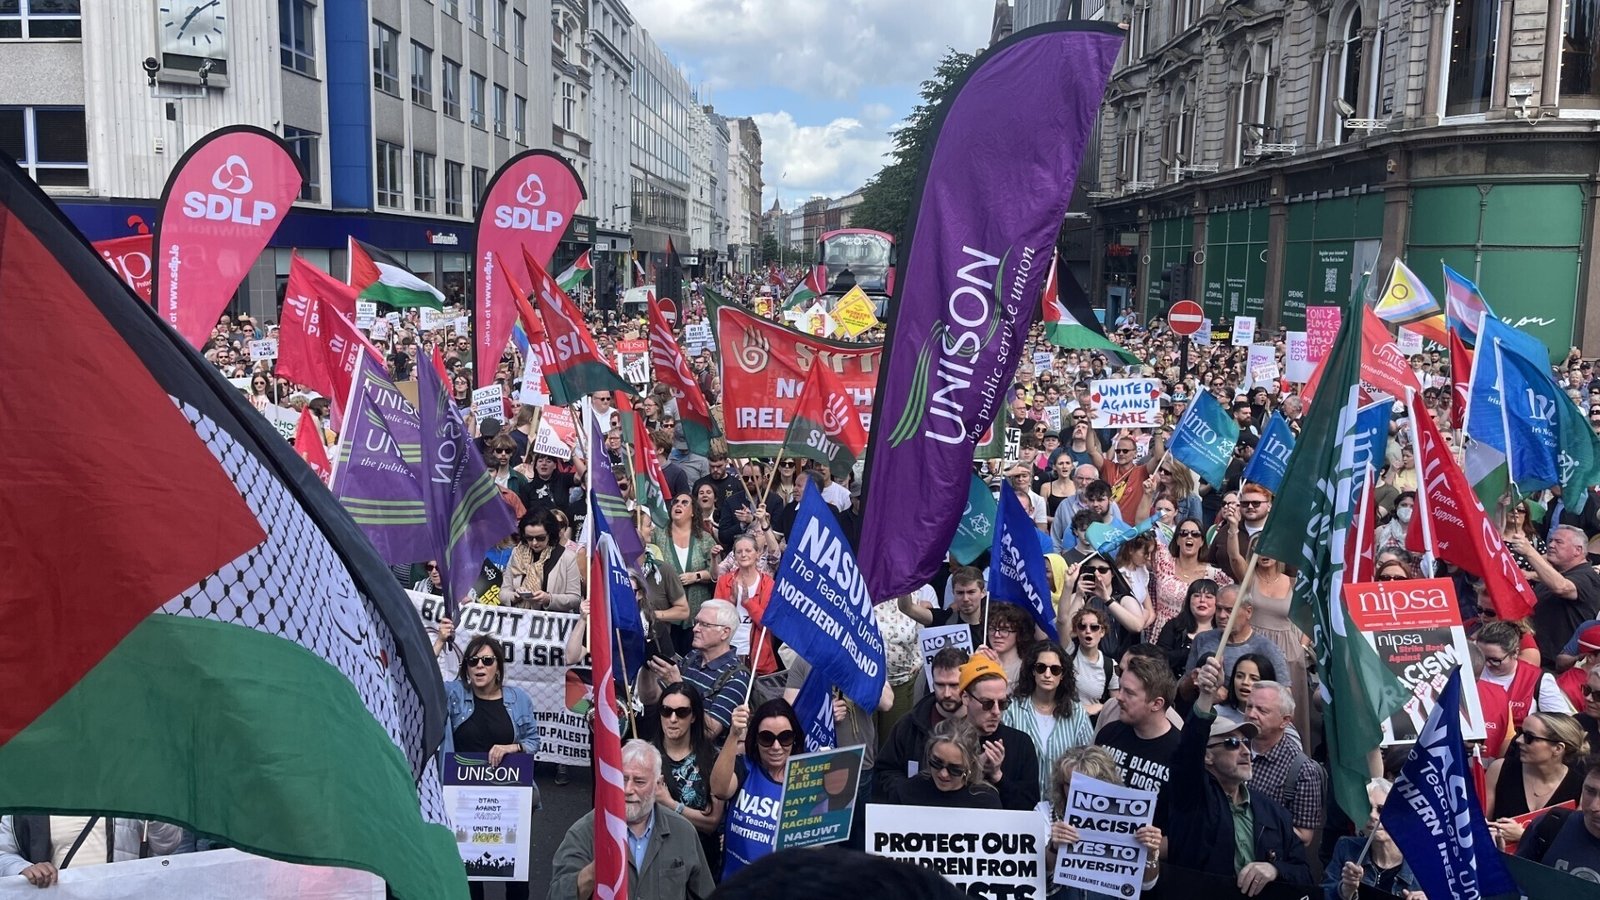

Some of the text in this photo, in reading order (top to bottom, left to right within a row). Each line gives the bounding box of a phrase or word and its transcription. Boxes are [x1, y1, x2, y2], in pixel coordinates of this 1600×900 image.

[182, 191, 276, 226] SDLP
[494, 205, 563, 232] SDLP
[168, 244, 182, 310] www.sdlp.ie
[483, 251, 494, 308] www.sdlp.ie
[169, 312, 177, 323] at
[485, 309, 491, 318] at
[1310, 308, 1335, 319] ONLY
[485, 320, 491, 329] us
[978, 367, 1003, 420] public
[997, 304, 1018, 364] service
[1011, 246, 1035, 301] union
[1311, 319, 1333, 329] LOVE
[620, 340, 645, 351] nipsa
[925, 245, 1000, 444] UNISON
[473, 387, 500, 400] NO TO
[1099, 382, 1154, 397] UNITED
[1101, 399, 1158, 410] AGAINST
[1108, 411, 1148, 425] HATE
[1184, 408, 1217, 444] into
[538, 435, 548, 444] TO
[535, 443, 570, 457] DIVISION
[360, 457, 409, 475] the public
[612, 570, 631, 588] The
[790, 553, 883, 655] The Teachers' Union
[1359, 583, 1449, 621] nipsa
[777, 577, 879, 678] NORTHERN IRELAND
[923, 631, 967, 651] NO TO
[1377, 633, 1423, 653] nipsa
[1398, 644, 1424, 653] Strike
[1388, 653, 1421, 663] Against
[811, 720, 827, 742] The
[457, 766, 520, 782] UNISON
[790, 763, 831, 776] EXCUSE
[1129, 755, 1170, 782] BLACKS
[787, 779, 823, 791] ABUSE
[1130, 772, 1161, 795] DOGS
[784, 797, 806, 807] SAY
[1074, 791, 1148, 816] NO TO
[732, 810, 743, 822] The
[781, 816, 823, 829] RACISM
[783, 809, 798, 818] TO
[783, 823, 841, 842] NASUWT
[1069, 814, 1147, 834] RACISM
[730, 822, 770, 845] NORTHERN
[874, 832, 1037, 854] PROTECT OUR
[1069, 840, 1137, 860] YES TO
[976, 859, 1038, 877] FROM
[1061, 858, 1139, 876] DIVERSITY
[1059, 872, 1121, 891] UNITED AGAINST RACISM
